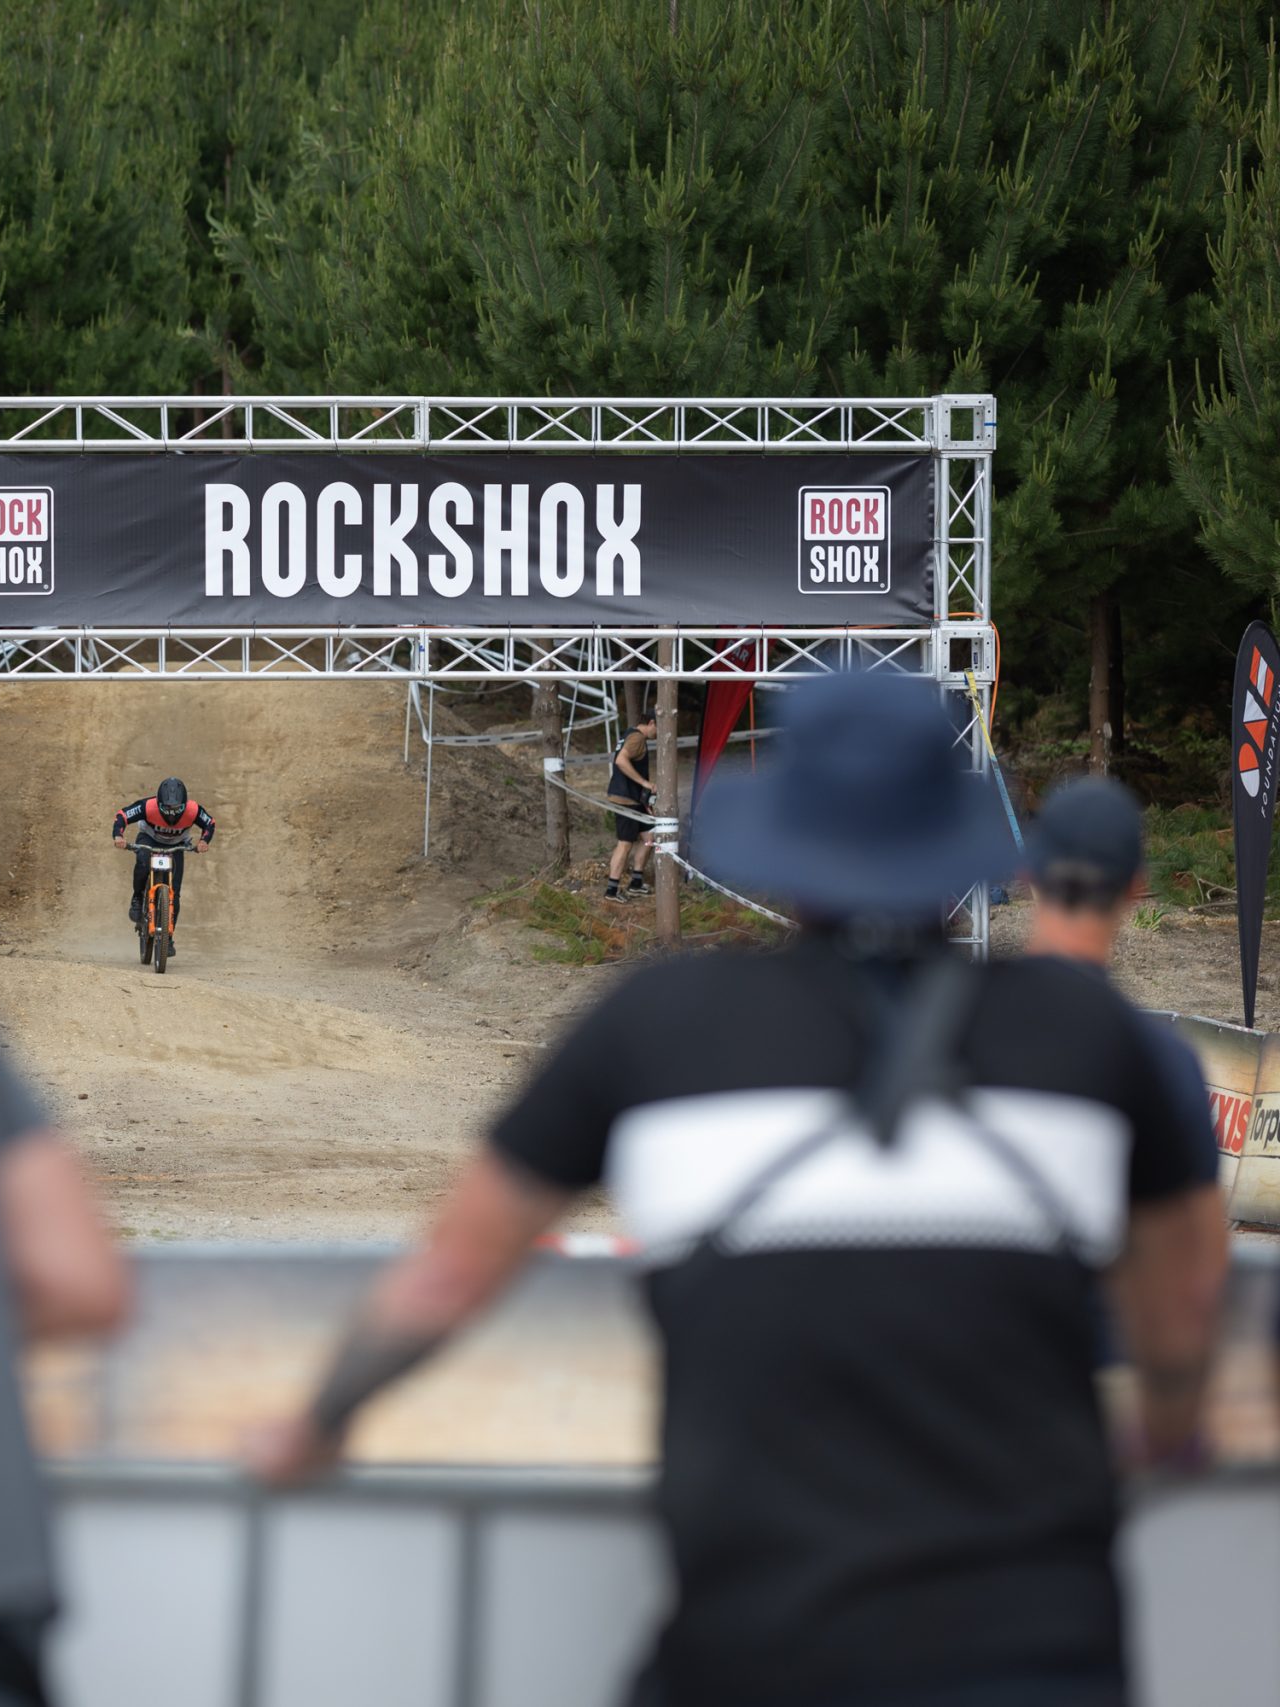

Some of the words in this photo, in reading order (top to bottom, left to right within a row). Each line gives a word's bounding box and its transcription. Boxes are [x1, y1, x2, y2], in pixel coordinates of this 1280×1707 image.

[810, 498, 879, 535] ROCK
[205, 481, 642, 598] ROCKSHOX
[810, 545, 879, 583] SHOX
